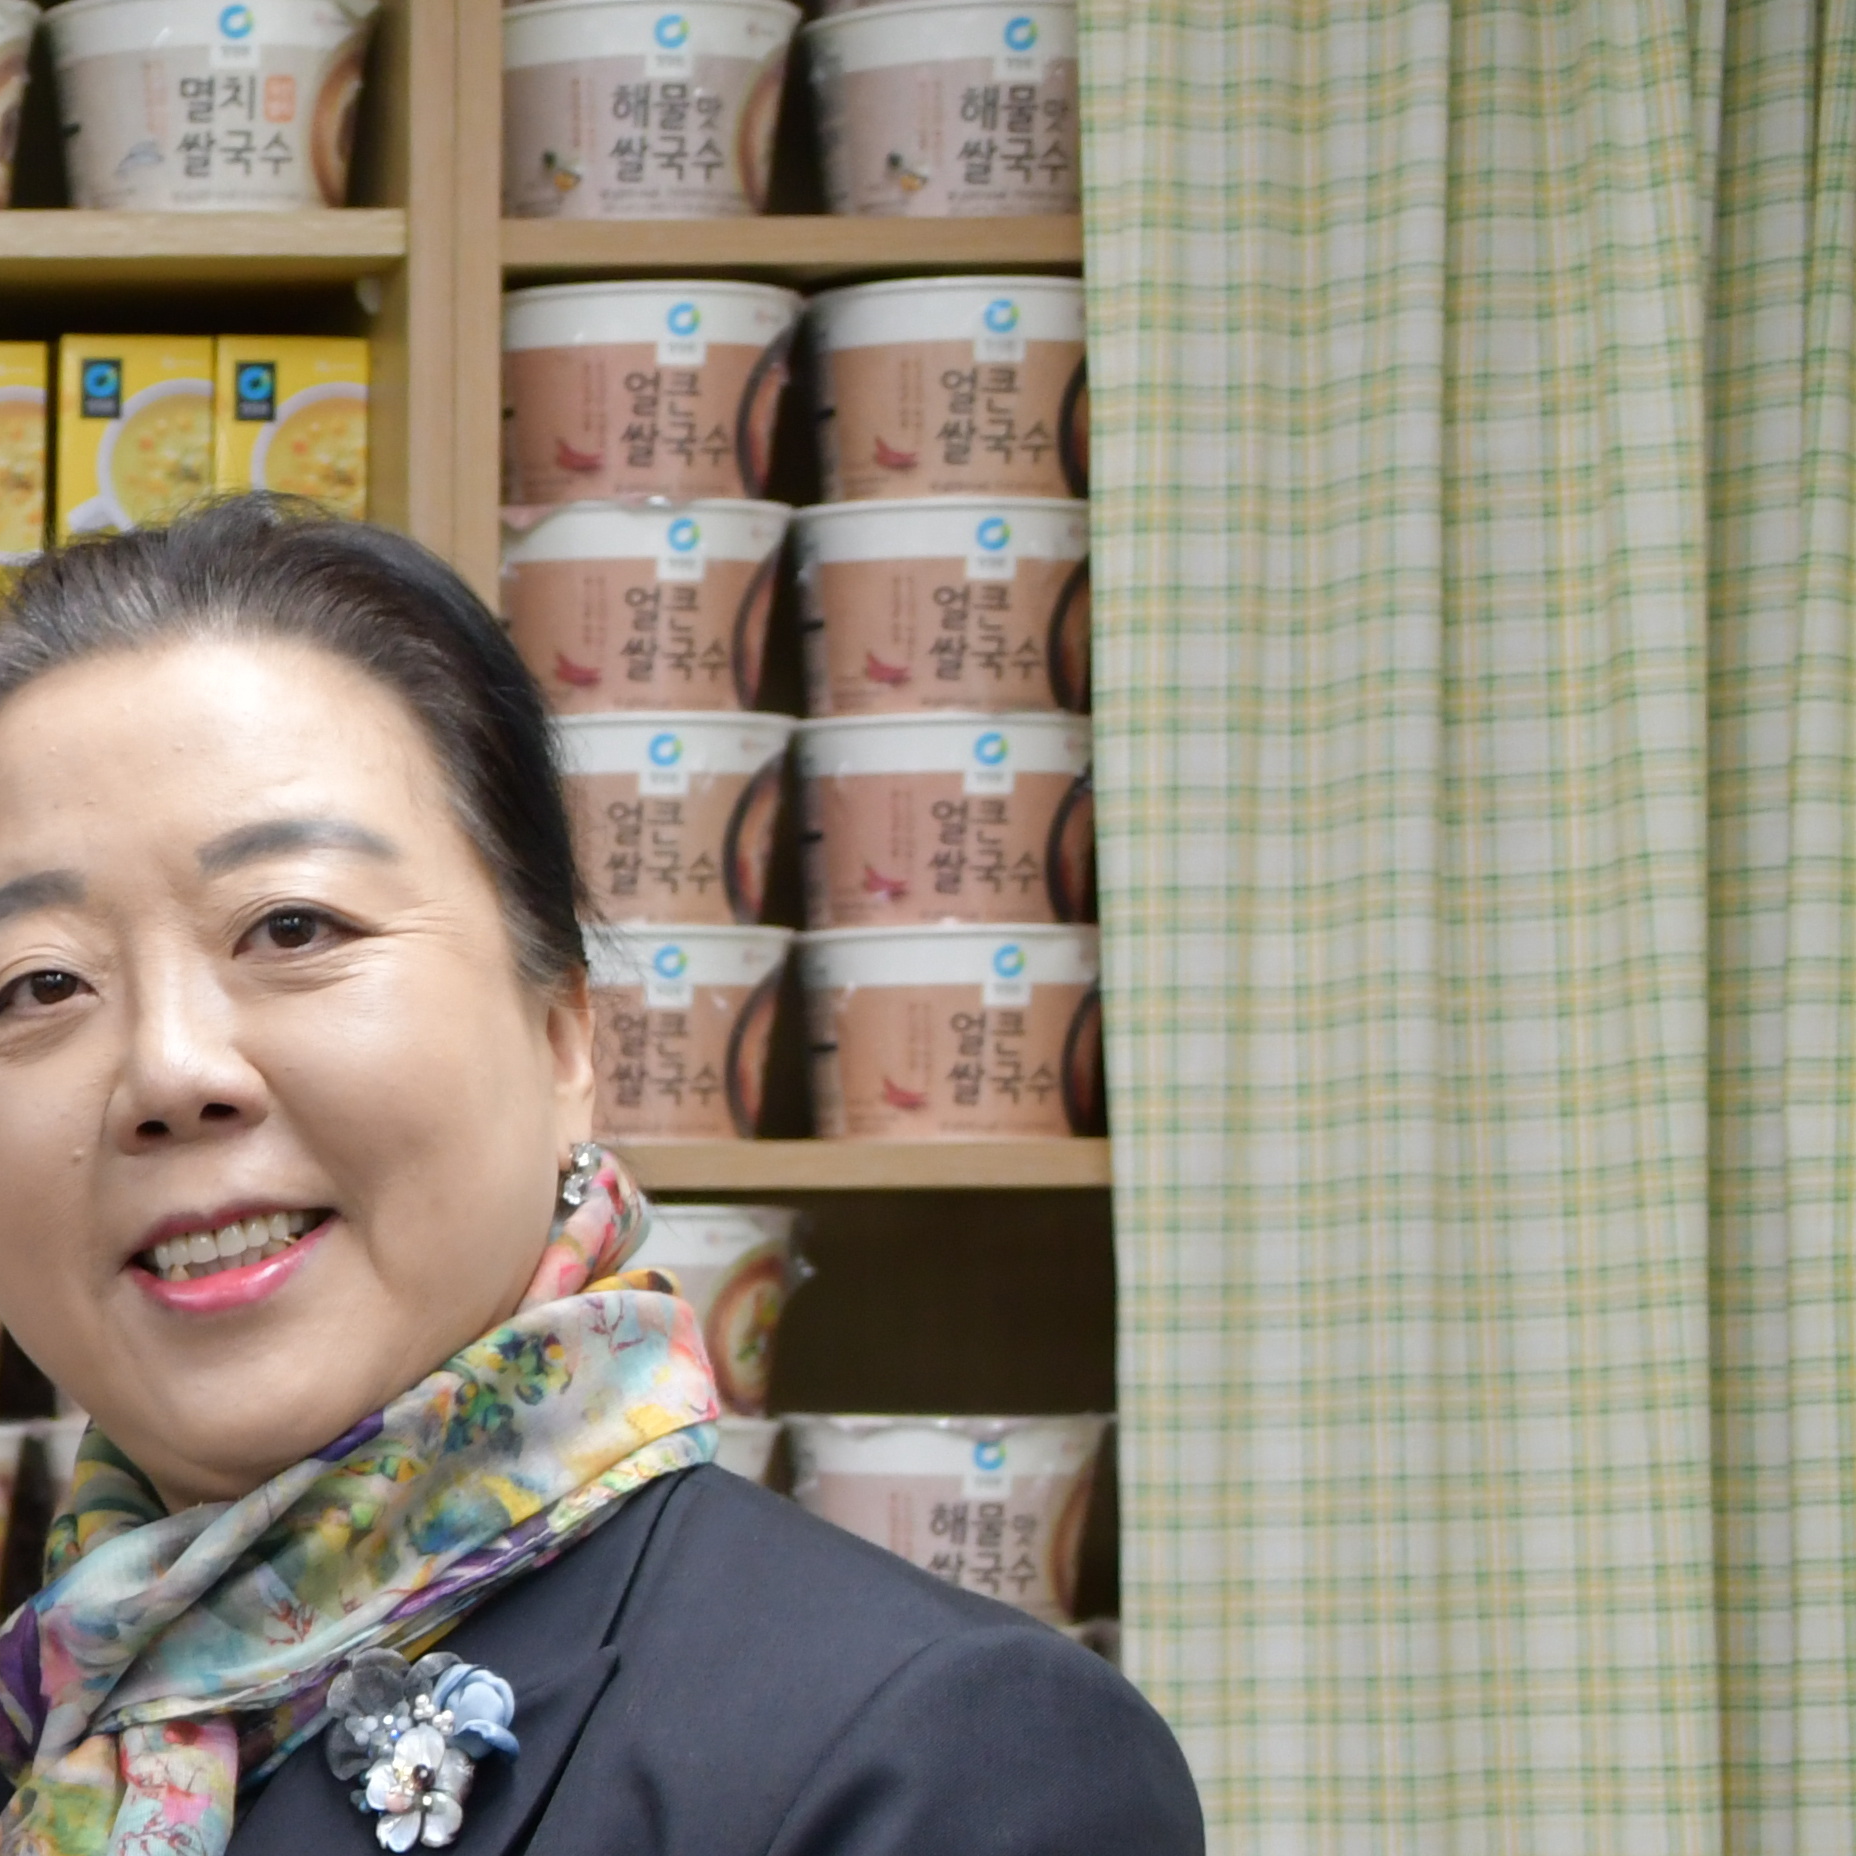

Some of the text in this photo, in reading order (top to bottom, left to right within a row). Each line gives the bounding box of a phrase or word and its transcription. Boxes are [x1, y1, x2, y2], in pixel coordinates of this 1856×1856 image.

[176, 76, 257, 128] 멸치
[174, 128, 294, 180] 쌀국수
[609, 136, 725, 184] 쌀국수
[957, 136, 1071, 184] 쌀국수
[623, 369, 699, 423] 얼큰
[941, 368, 1019, 422] 얼큰
[620, 422, 732, 470] 쌀국수
[935, 420, 1050, 468] 쌀국수
[623, 587, 699, 638] 얼큰
[932, 586, 1009, 637] 얼큰
[619, 636, 730, 684] 쌀국수
[929, 636, 1041, 683] 쌀국수
[931, 798, 1009, 848] 얼큰
[604, 847, 719, 896] 쌀국수
[928, 846, 1041, 895] 쌀국수
[950, 1010, 1025, 1059] 얼큰
[611, 1059, 722, 1109] 쌀국수
[946, 1058, 1058, 1107] 쌀국수
